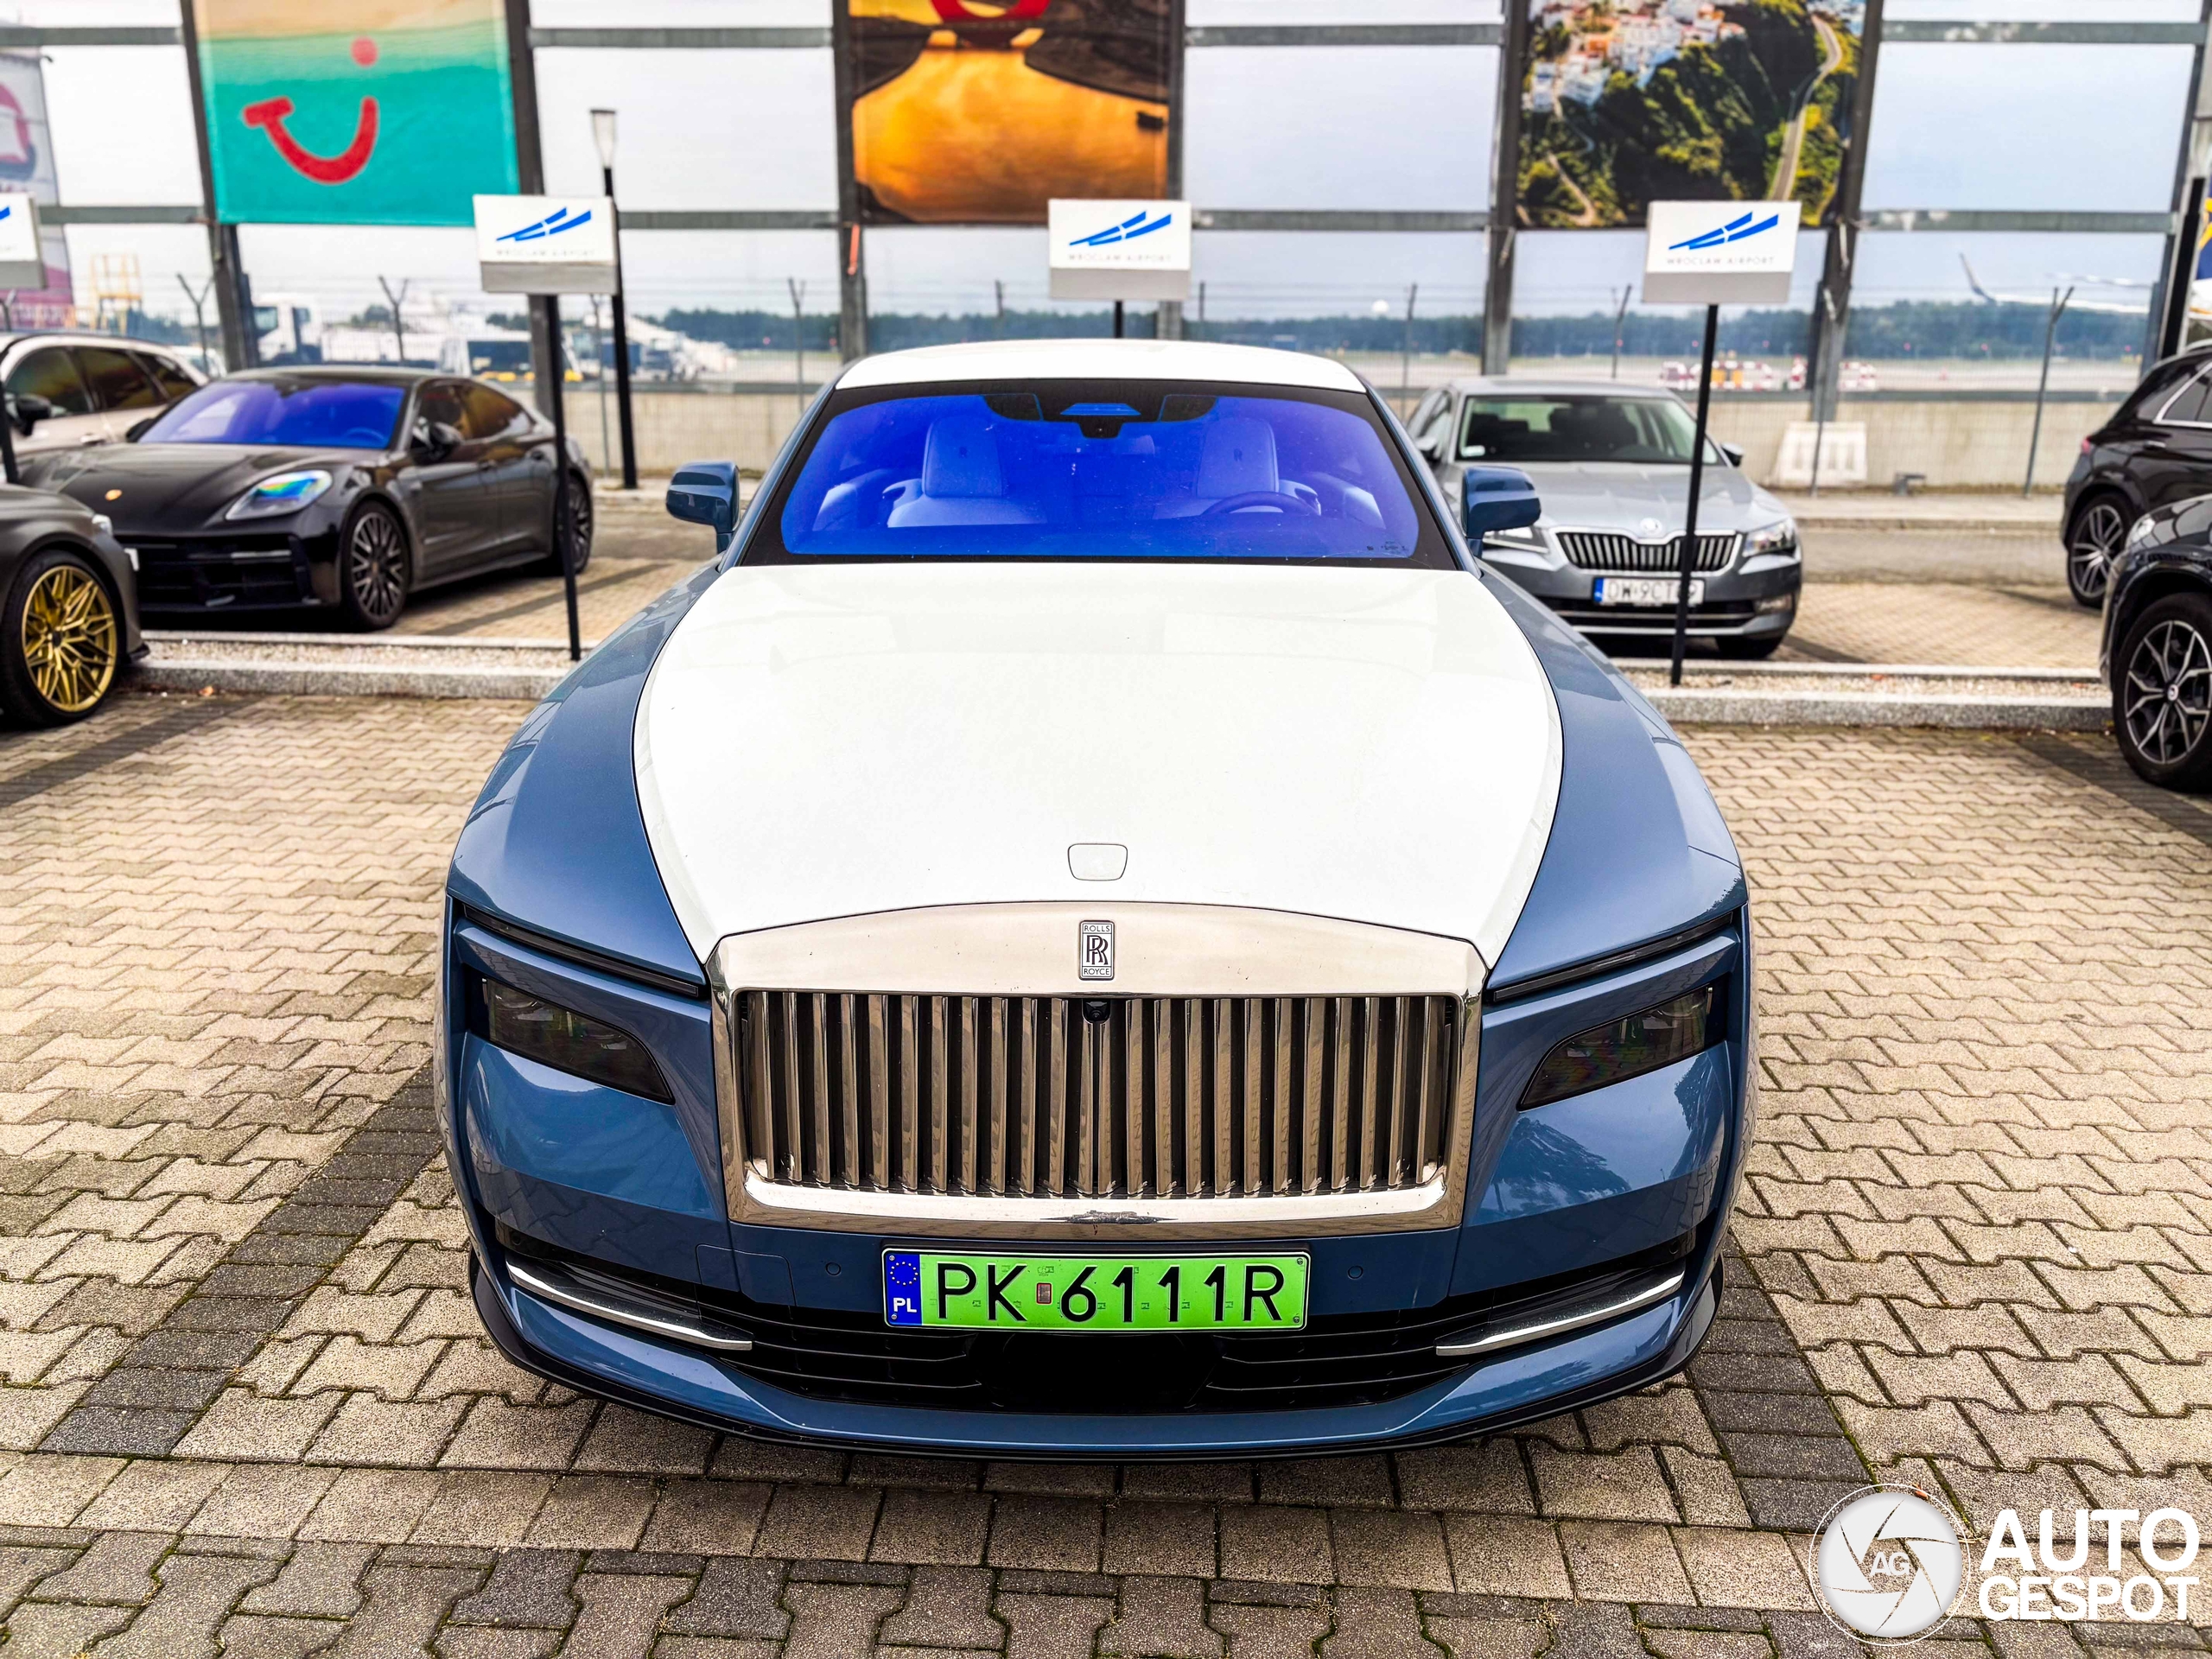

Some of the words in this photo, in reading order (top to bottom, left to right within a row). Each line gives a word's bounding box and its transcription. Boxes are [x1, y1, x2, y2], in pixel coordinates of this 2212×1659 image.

[893, 1297, 918, 1313] PL
[937, 1262, 1028, 1322] PK
[1060, 1263, 1284, 1323] 6111R
